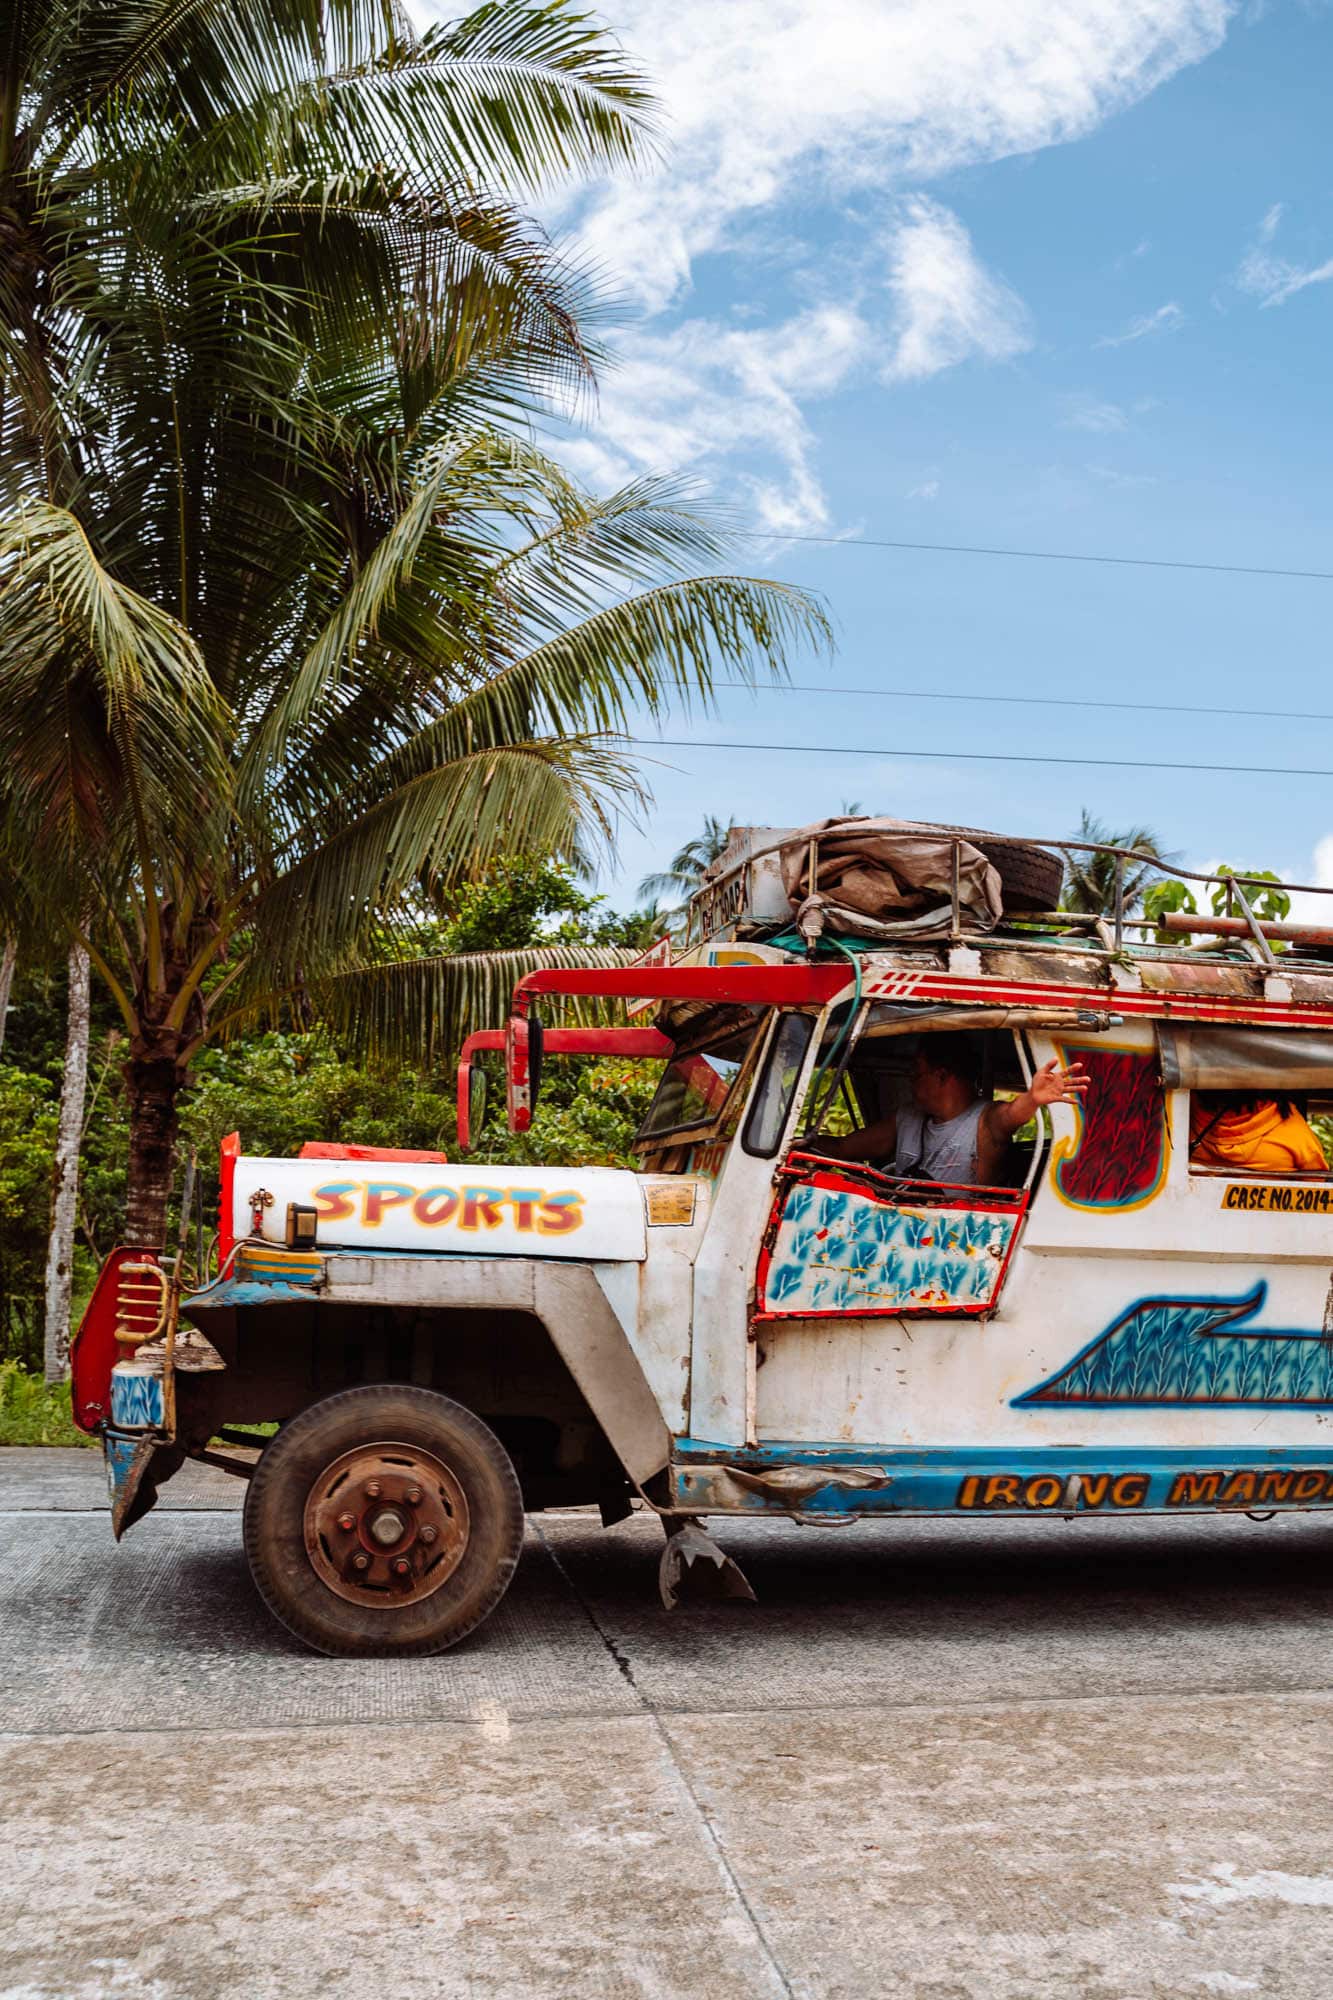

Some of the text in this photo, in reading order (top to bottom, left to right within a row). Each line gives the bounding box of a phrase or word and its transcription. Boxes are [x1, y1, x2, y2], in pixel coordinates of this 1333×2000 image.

[313, 1180, 587, 1237] SPORTS
[1226, 1186, 1267, 1209] CASE
[1269, 1187, 1293, 1210] NO.
[1165, 1470, 1333, 1508] MAND
